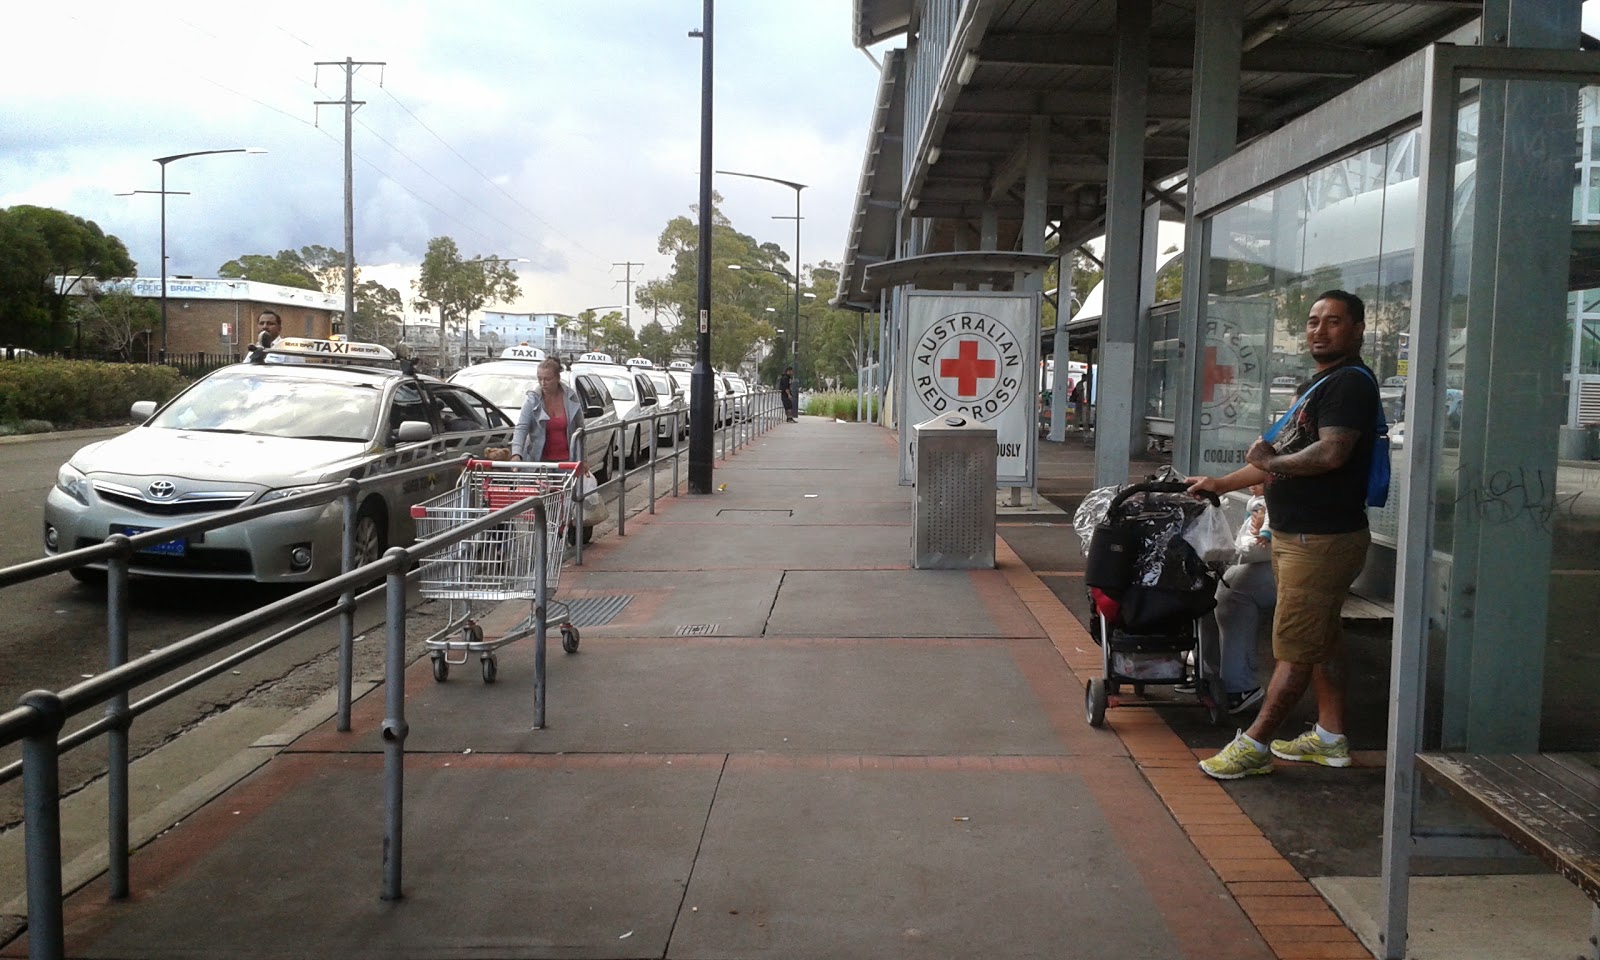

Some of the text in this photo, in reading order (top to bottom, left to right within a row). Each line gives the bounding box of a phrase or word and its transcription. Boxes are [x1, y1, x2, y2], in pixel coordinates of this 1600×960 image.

[137, 284, 162, 292] POLIC
[917, 316, 1019, 367] AUSTRALIAN
[314, 341, 349, 354] TAXI
[511, 349, 537, 358] TAXI
[586, 354, 606, 362] TAXI
[917, 375, 947, 411] RED
